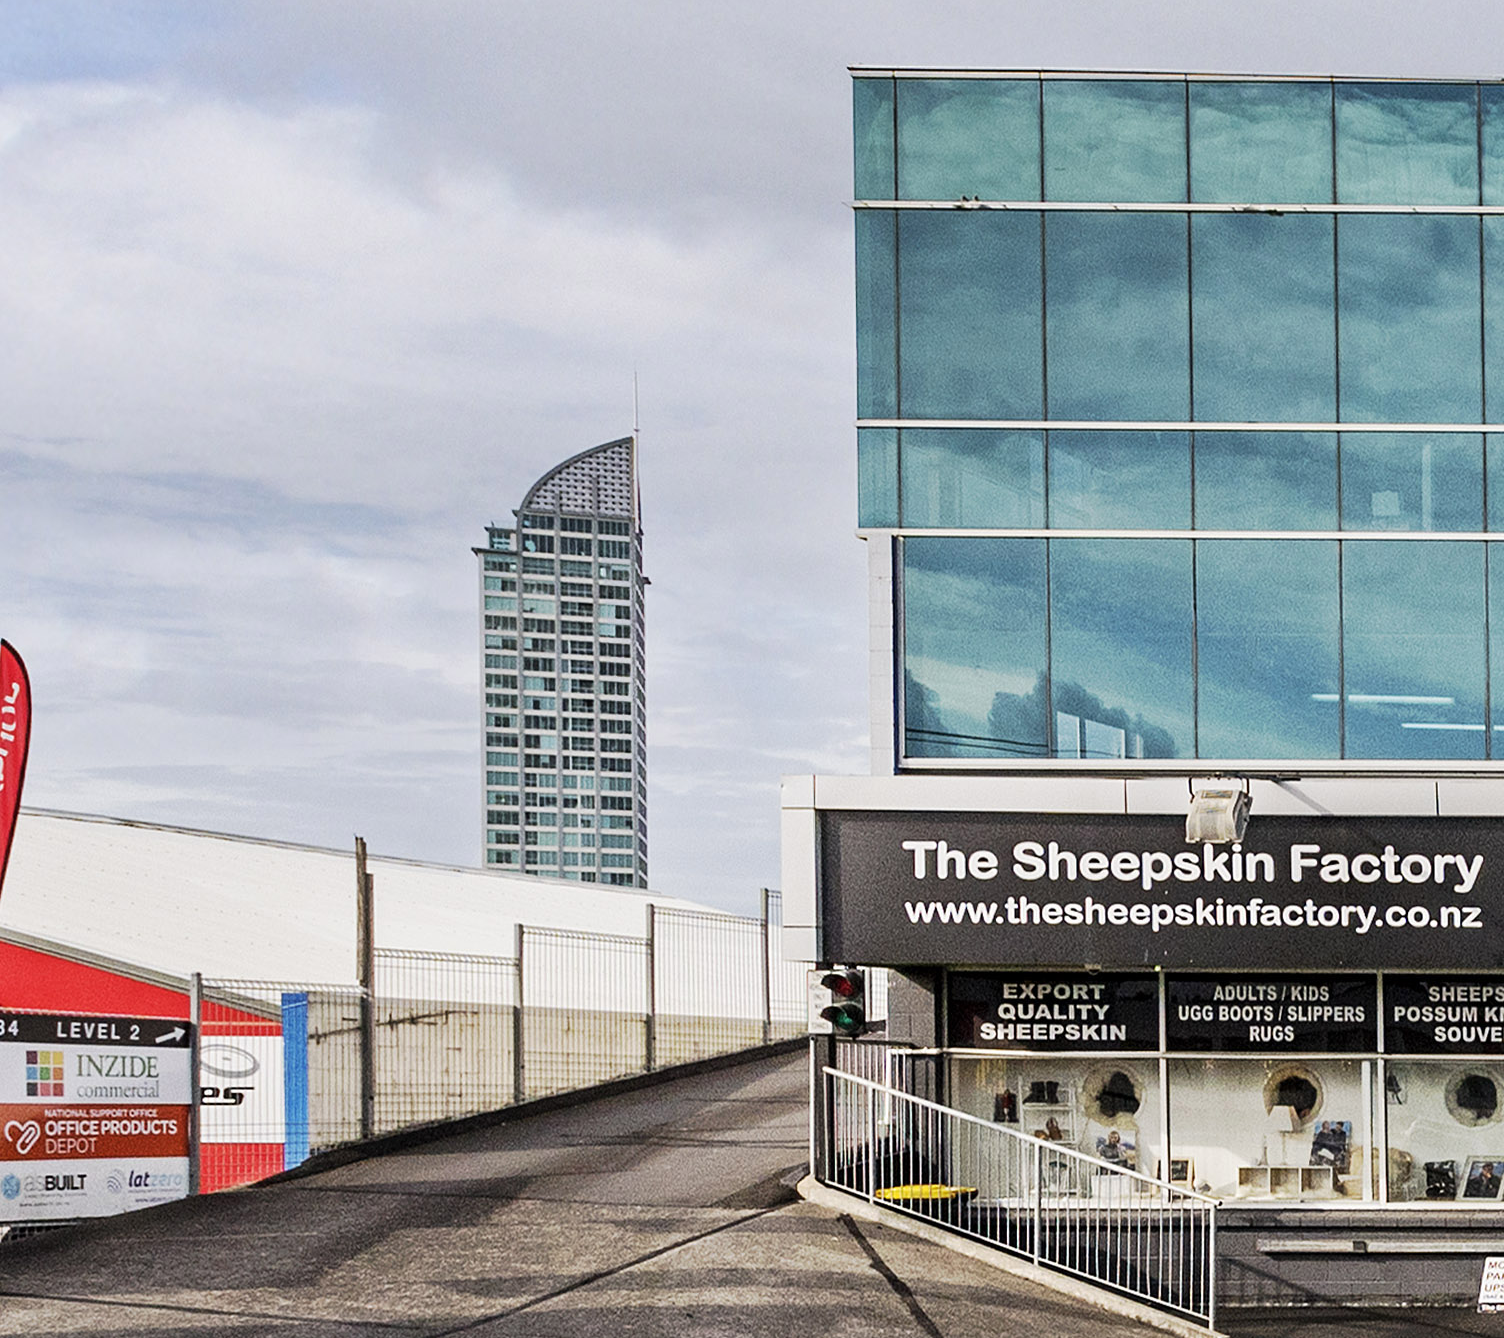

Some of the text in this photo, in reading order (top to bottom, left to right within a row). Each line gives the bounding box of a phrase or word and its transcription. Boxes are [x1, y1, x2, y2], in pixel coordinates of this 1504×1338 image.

[902, 841, 1485, 893] The Sheepskin Factory
[904, 896, 1484, 934] www.thesheepskinfactory.co.nz
[1002, 983, 1106, 1000] EXPORT
[1213, 985, 1278, 1001] ADULTS
[1290, 985, 1330, 1001] KIDS
[997, 1003, 1110, 1022] QUALITY
[1178, 1005, 1214, 1022] UGG
[1218, 1006, 1274, 1022] BOOTS
[1287, 1006, 1366, 1023] SLIPPERS
[1393, 1006, 1478, 1022] POSSUM
[57, 1022, 121, 1040] LEVEL
[130, 1025, 141, 1040] 2
[979, 1023, 1127, 1041] SHEEPSKIN
[1248, 1026, 1295, 1042] RUGS
[77, 1054, 160, 1078] INZIDE
[77, 1081, 160, 1099] commercial
[44, 1109, 158, 1118] NATIONAL SUPPORT OFFICE
[45, 1120, 178, 1136] OFFICE PRODUCTS
[45, 1138, 97, 1154] DEPOT
